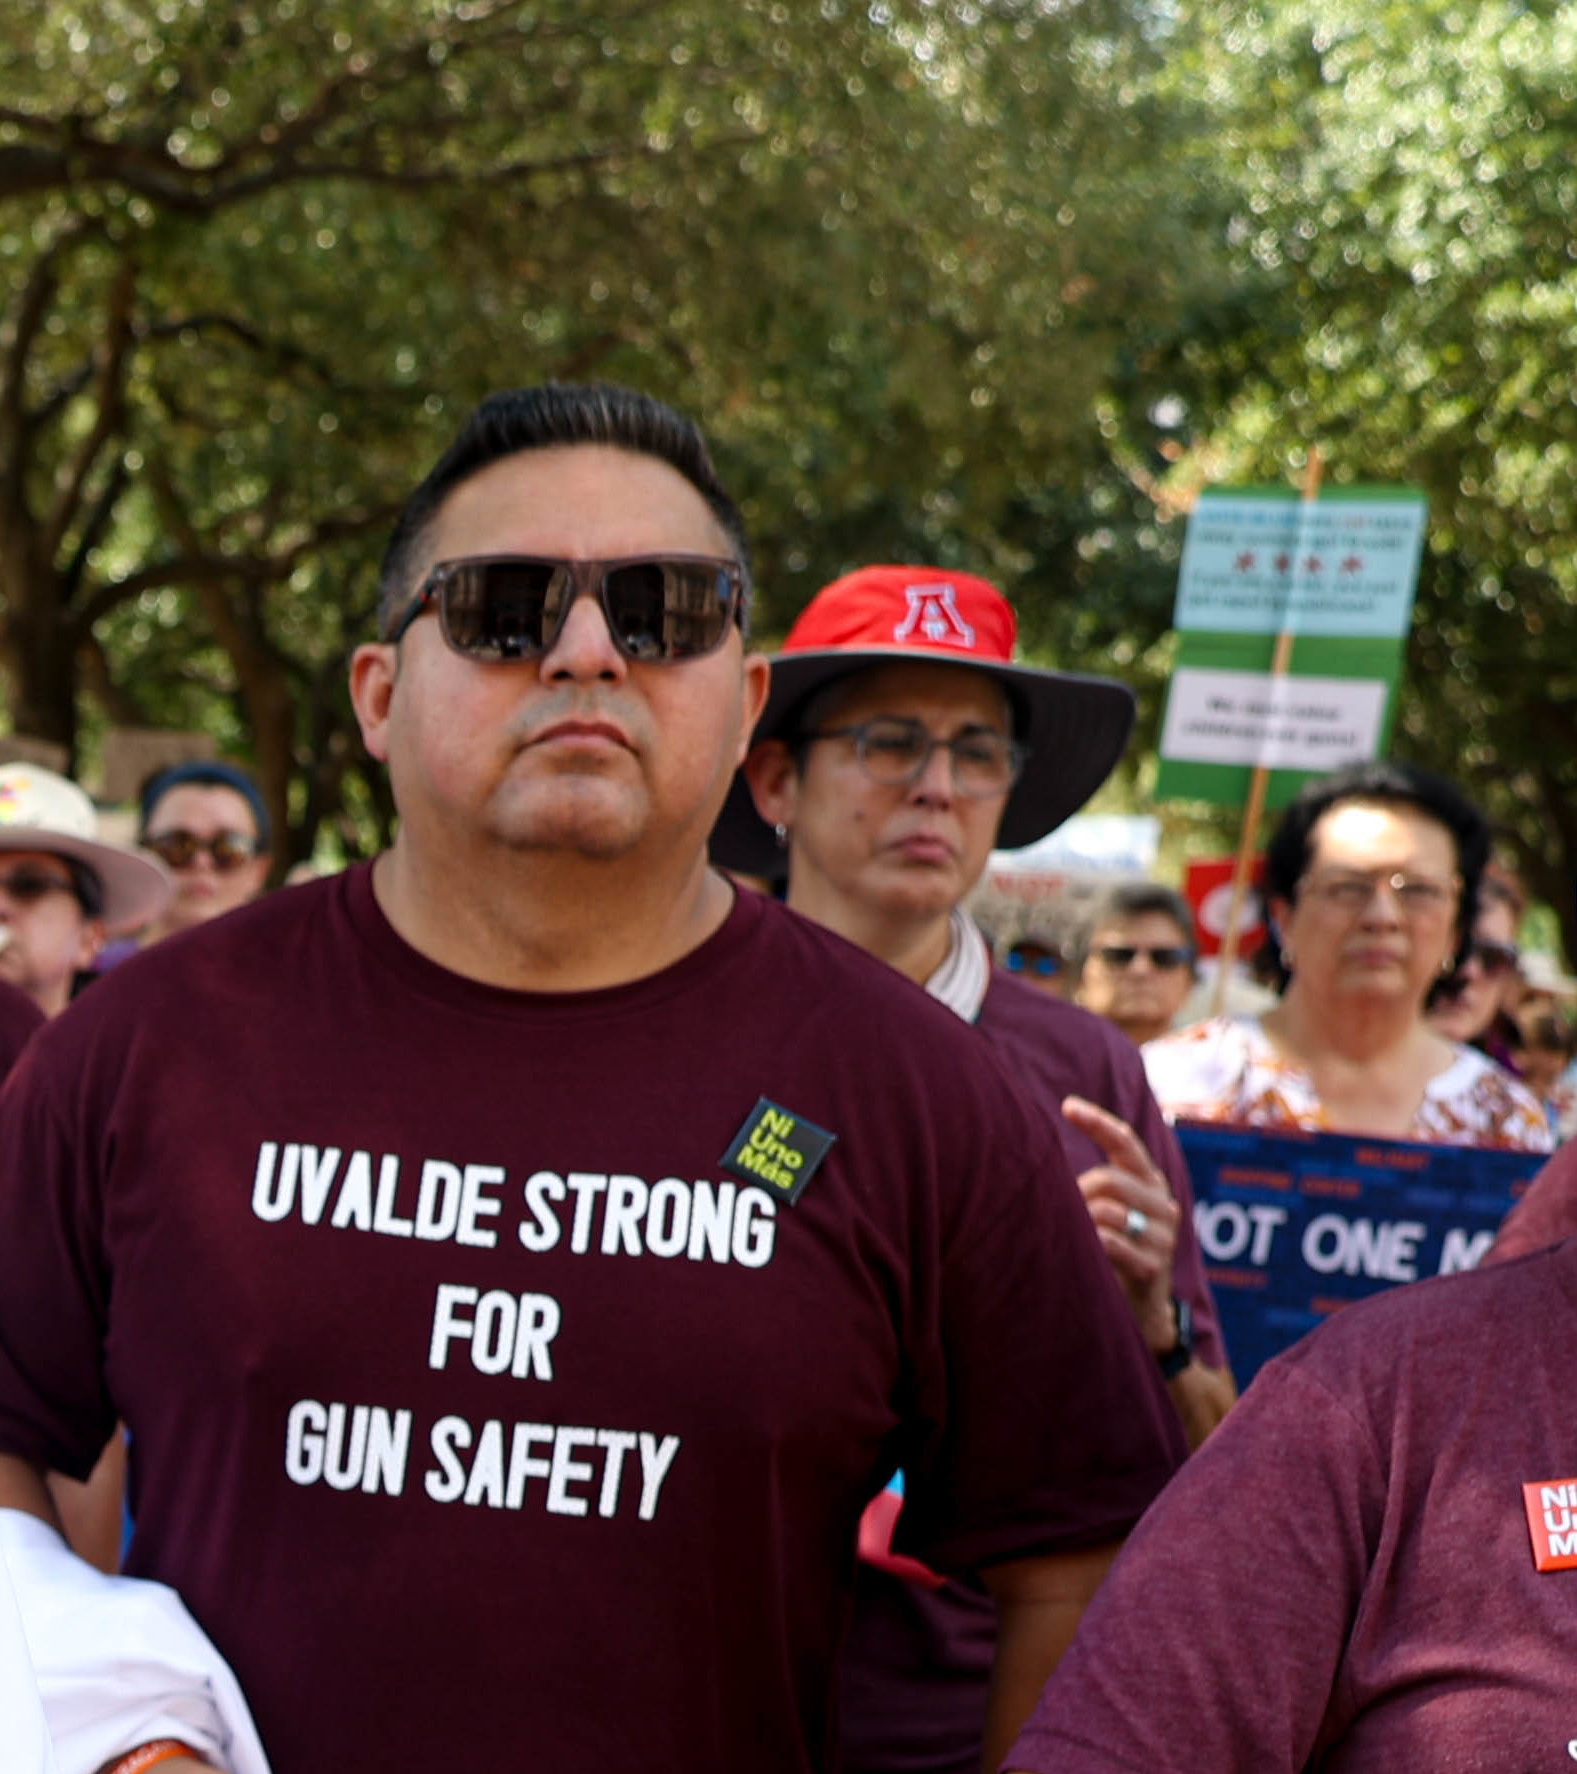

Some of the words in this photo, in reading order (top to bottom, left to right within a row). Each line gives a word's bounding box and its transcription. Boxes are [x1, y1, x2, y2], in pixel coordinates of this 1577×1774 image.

[750, 1126, 804, 1170] Uno
[251, 1141, 506, 1249] UVALDE
[518, 1171, 777, 1269] STRONG
[1302, 1213, 1426, 1282] ONE
[428, 1283, 561, 1381] FOR
[284, 1399, 412, 1497] GUN
[423, 1415, 680, 1521] SAFETY
